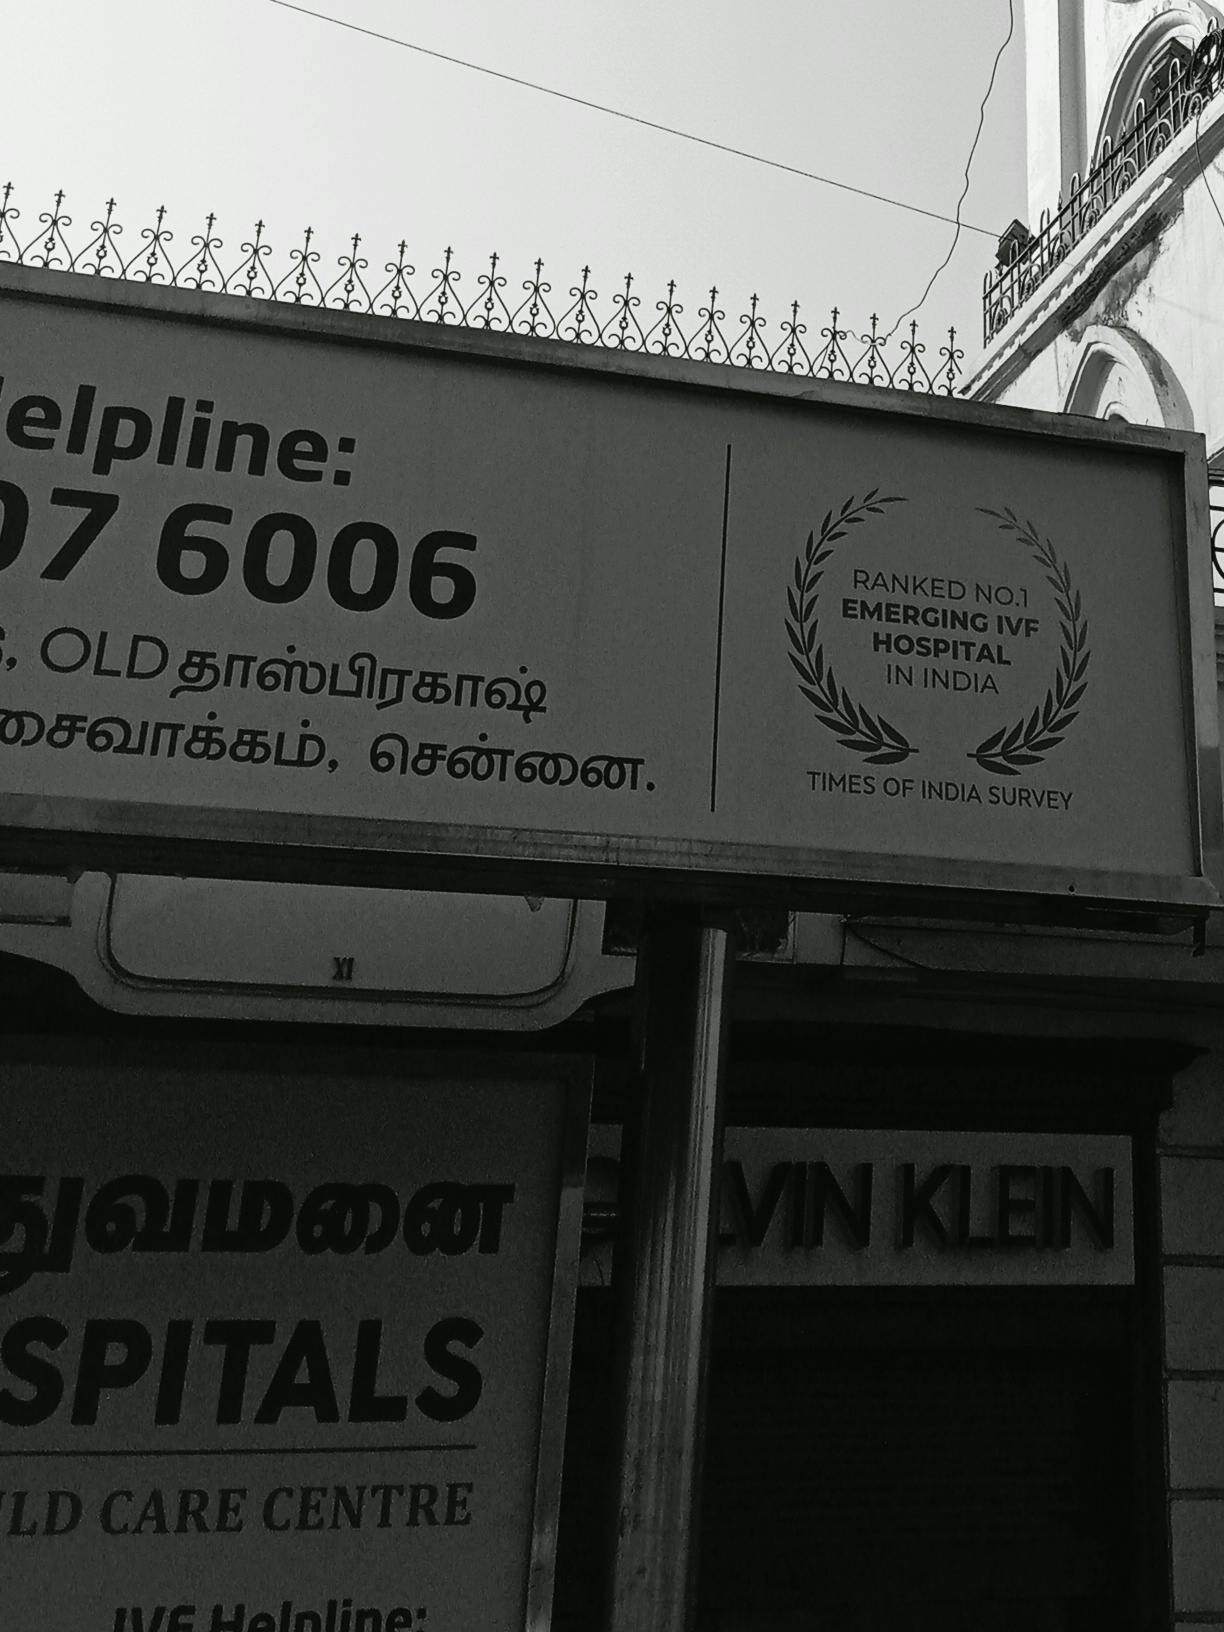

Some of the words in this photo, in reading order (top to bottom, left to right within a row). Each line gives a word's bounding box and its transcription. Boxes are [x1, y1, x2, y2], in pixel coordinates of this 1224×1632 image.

[0, 376, 355, 486] elpline:
[157, 503, 477, 619] 6006
[854, 569, 966, 600] RANKED
[976, 583, 1028, 608] NO.1
[843, 598, 989, 633] EMERGING
[996, 615, 1040, 638] IVF
[41, 627, 169, 679] OLD
[170, 645, 547, 724] தாஸ்பிரகாஷ்
[873, 632, 1012, 666] HOSPITAL
[887, 664, 913, 686] IN
[923, 668, 1000, 694] INDIA
[370, 733, 656, 792] சென்னை.
[807, 771, 876, 795] TIMES
[882, 778, 915, 798] OF
[921, 780, 983, 804] INDIA
[989, 786, 1073, 811] SURVEY
[902, 1163, 1115, 1251] KLEIN
[0, 1316, 485, 1427] SPITALS
[99, 1486, 248, 1535] CARE
[262, 1482, 474, 1532] CENTRE
